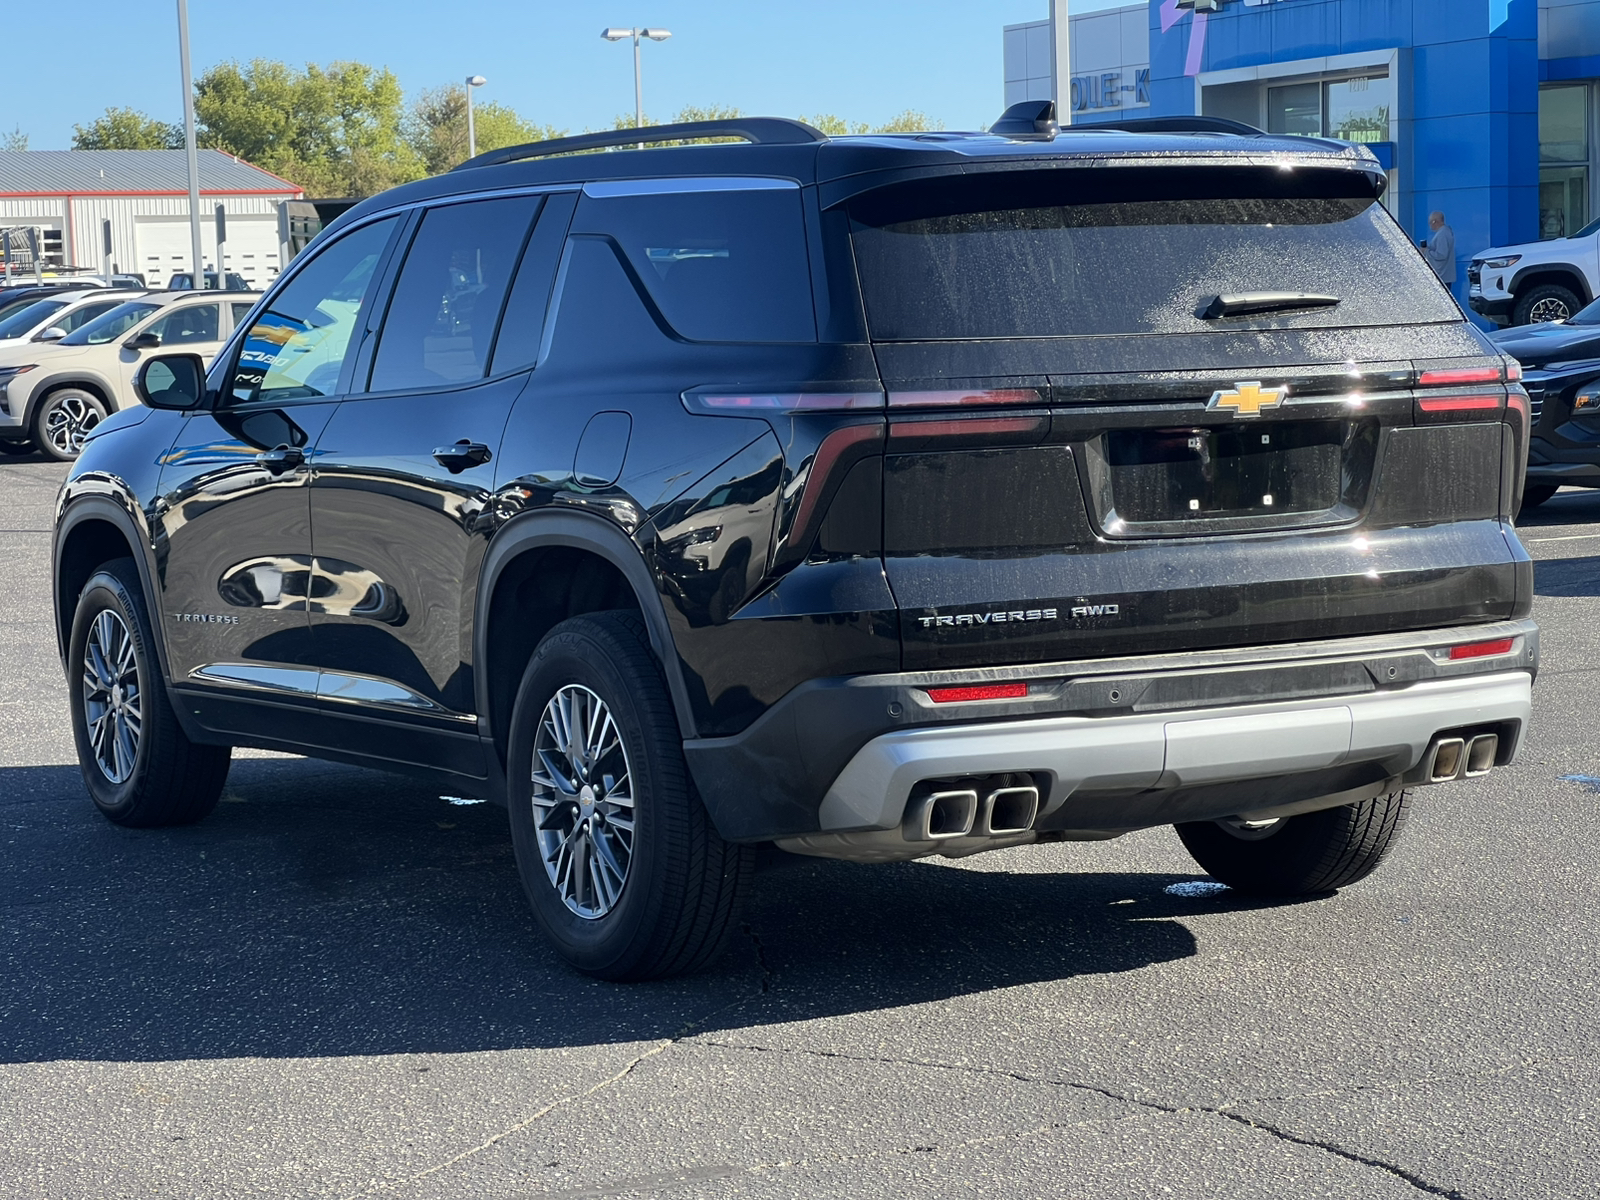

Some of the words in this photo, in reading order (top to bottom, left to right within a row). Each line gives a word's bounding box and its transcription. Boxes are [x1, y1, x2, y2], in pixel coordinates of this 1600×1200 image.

[117, 588, 145, 658] BRIDGESTONE
[174, 613, 239, 625] TRAVERSE
[918, 608, 1058, 628] TRAVERSE
[1070, 604, 1119, 618] AWD
